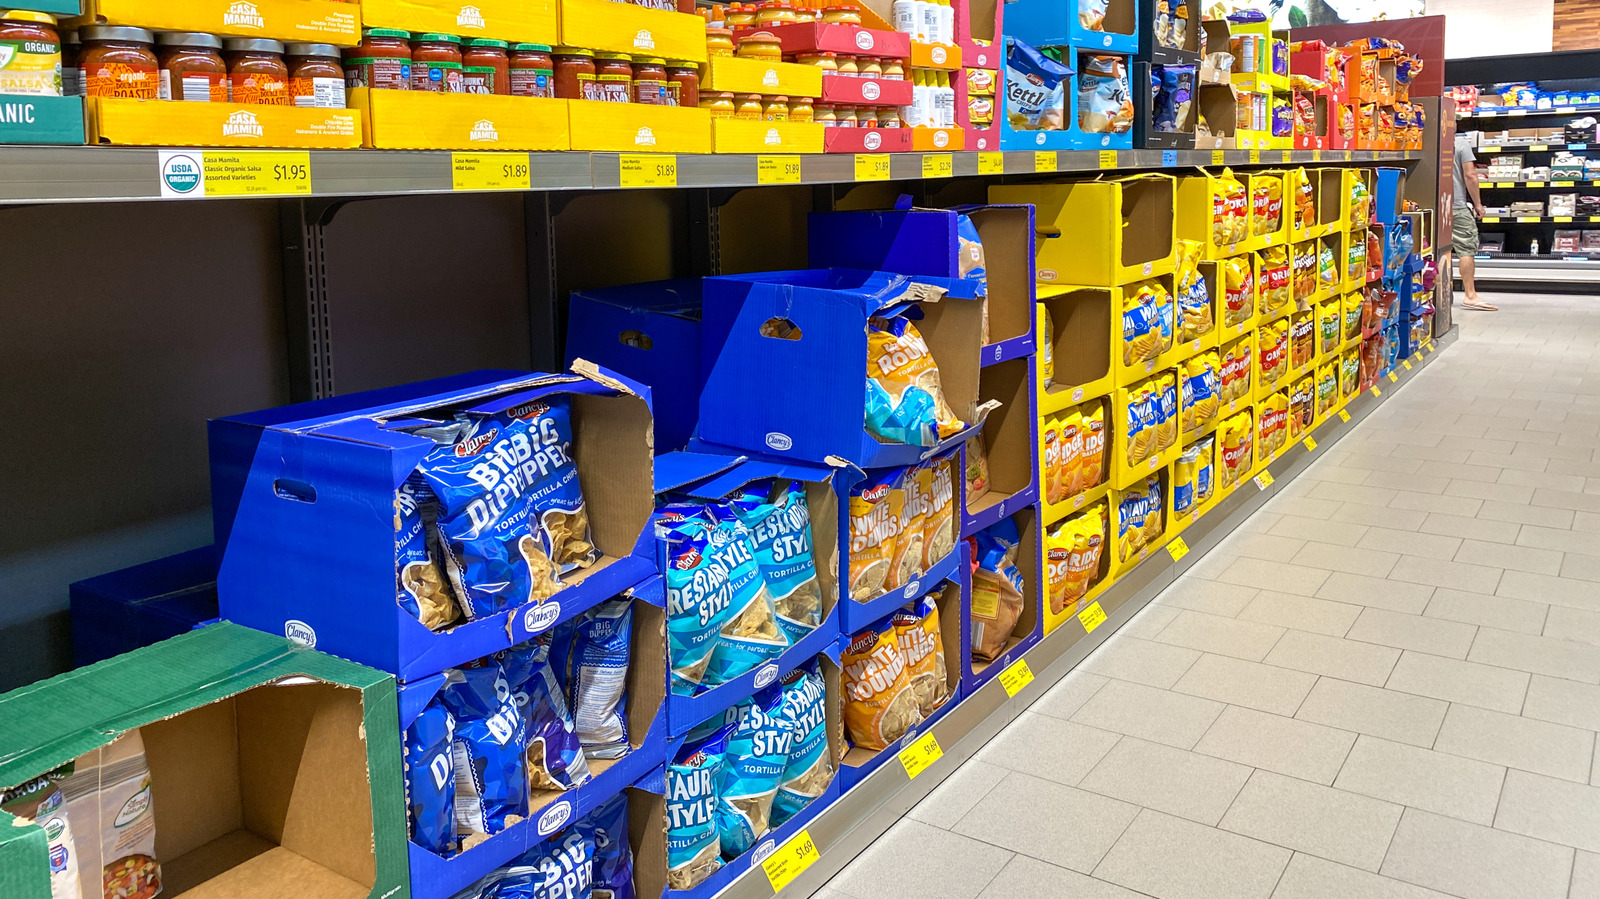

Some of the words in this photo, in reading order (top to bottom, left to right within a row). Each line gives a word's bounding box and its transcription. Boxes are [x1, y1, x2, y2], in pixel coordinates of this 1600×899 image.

[230, 5, 257, 16] CASA
[459, 8, 480, 17] CASA
[223, 13, 264, 28] MAMITA
[456, 16, 486, 28] MAMITA
[25, 42, 56, 54] ORGANIC
[1, 78, 42, 90] SALSA
[121, 72, 148, 84] organic
[116, 81, 139, 90] DOUBLE
[1007, 78, 1046, 107] Kettl
[229, 114, 257, 124] CASA
[222, 123, 264, 137] MAMITA
[474, 122, 494, 132] CASA
[470, 130, 499, 142] MAMITA
[171, 164, 192, 173] USDA
[224, 165, 246, 173] Organic
[273, 163, 307, 182] $1.95
[503, 164, 528, 179] $1.89
[656, 164, 675, 177] $1.89
[785, 164, 800, 175] $1.89
[875, 162, 889, 171] $1.89
[168, 175, 196, 183] ORGANIC
[505, 402, 550, 419] Clancy's
[454, 427, 498, 458] Clancy's
[562, 468, 578, 485] CHIPS
[548, 498, 565, 507] great
[853, 515, 899, 554] OUNDS
[406, 550, 424, 560] great
[1069, 546, 1099, 568] RIDG
[769, 564, 806, 580] TORTILLA
[527, 605, 560, 629] Clancy's
[287, 623, 316, 644] Clancy's
[843, 630, 879, 656] Clancy's
[844, 642, 897, 681] WHITE
[845, 652, 905, 701] ROUND
[790, 738, 820, 760] TORTILLA
[924, 740, 938, 755] $1.69
[744, 765, 776, 775] TORTILLA
[539, 805, 570, 832] Clancy's
[669, 838, 697, 848] RTILLA
[796, 840, 813, 860] $1.69
